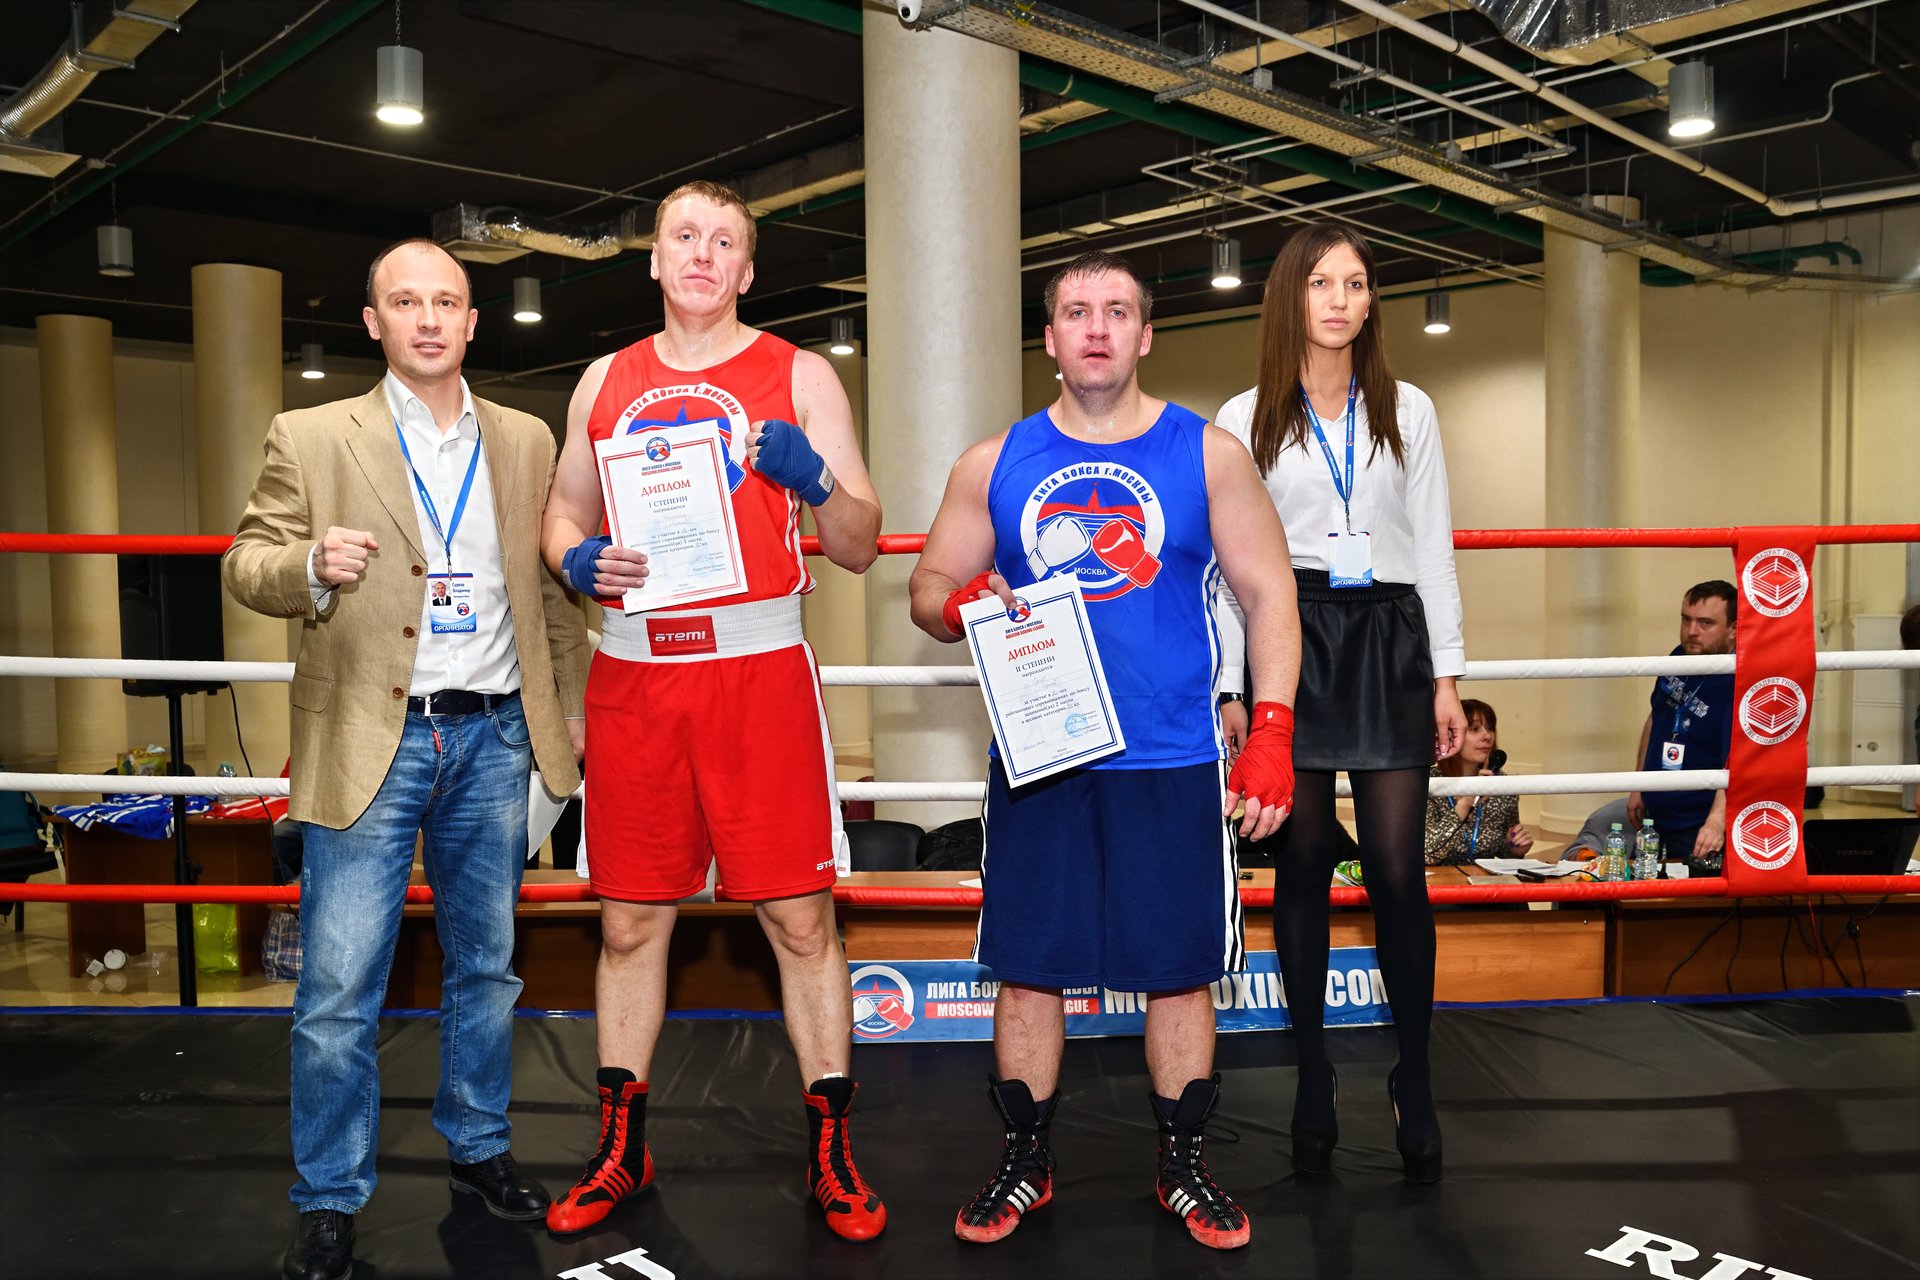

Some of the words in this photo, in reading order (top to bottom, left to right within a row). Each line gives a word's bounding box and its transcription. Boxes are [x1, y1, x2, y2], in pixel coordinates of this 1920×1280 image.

[641, 479, 691, 497] ДИПЛОМ
[1033, 477, 1060, 502] ЛИГА
[1062, 466, 1100, 480] БОКСА
[653, 496, 688, 507] СТЕПЕНИ
[1074, 567, 1107, 576] МОСКВА
[434, 624, 474, 632] ОРГАНИЗАТОР
[1008, 638, 1056, 662] ДИПЛОМ
[1022, 655, 1055, 671] СТЕПЕНИ
[1741, 802, 1770, 817] КВАДРАТ
[1752, 860, 1782, 869] SQUARED
[926, 982, 967, 999] ЛИГА
[970, 981, 1001, 998] БОК
[937, 1003, 995, 1017] MOSCOW
